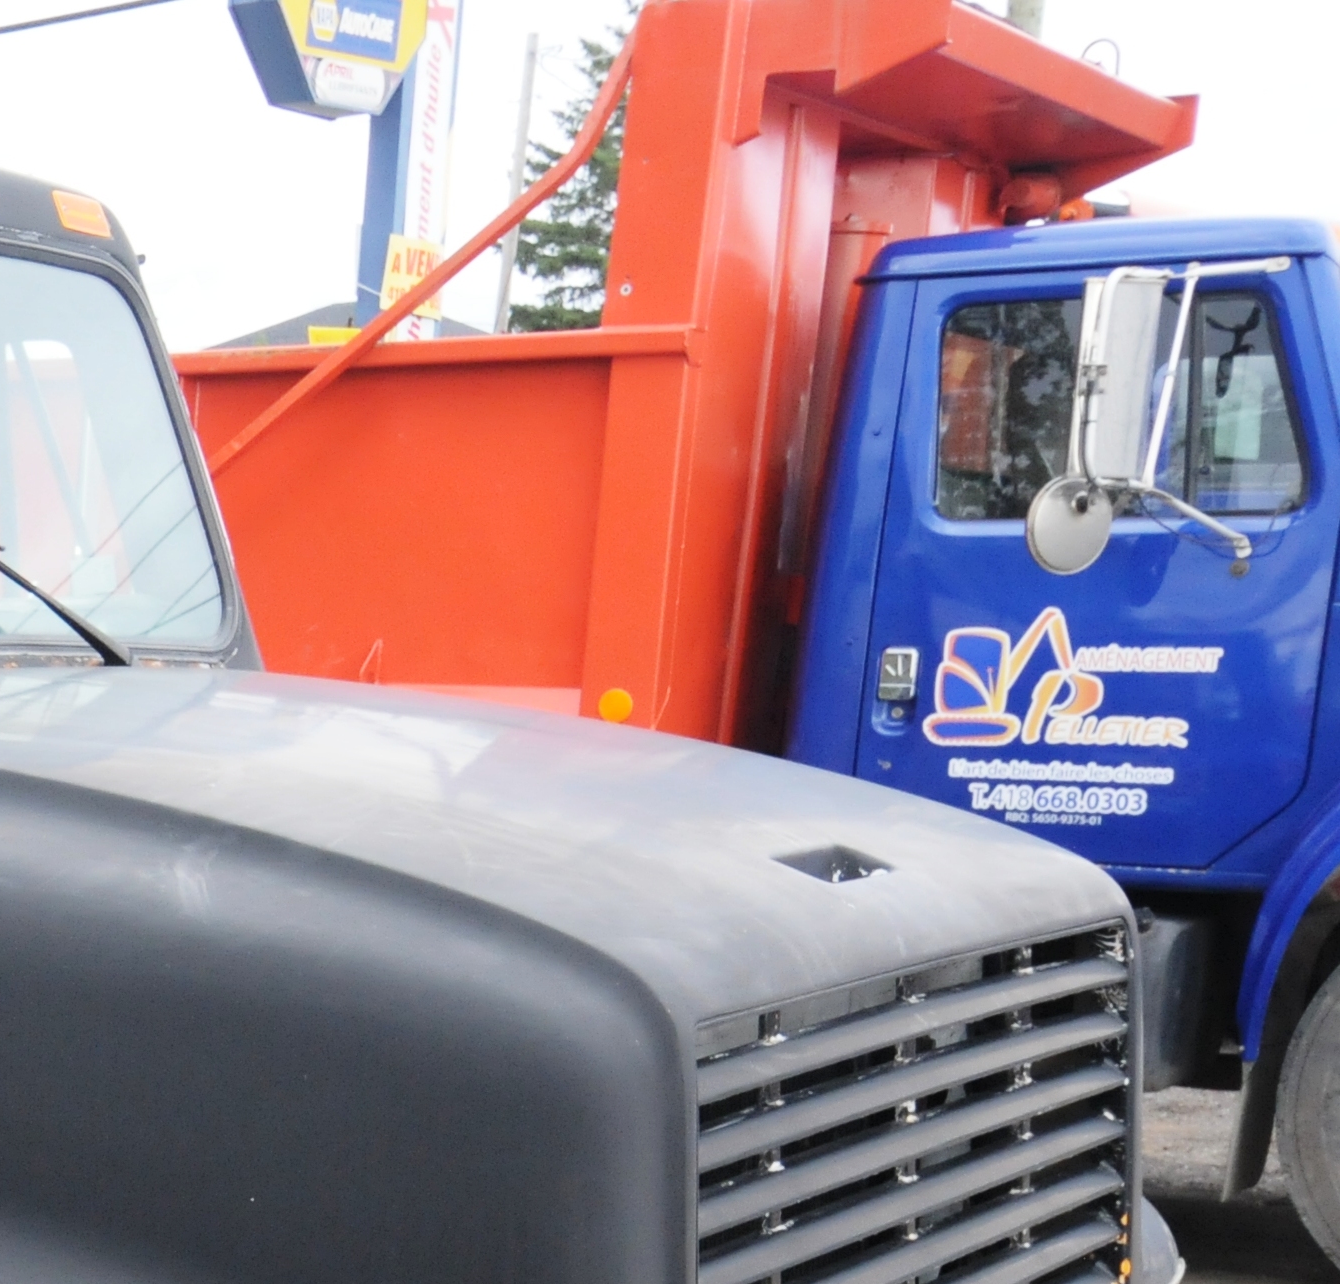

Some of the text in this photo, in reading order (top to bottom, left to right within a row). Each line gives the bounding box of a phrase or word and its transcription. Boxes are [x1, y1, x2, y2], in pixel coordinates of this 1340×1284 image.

[1075, 645, 1222, 671] AMÉNAGEMENT
[987, 761, 1009, 778] de
[1011, 761, 1046, 780] bien
[1049, 762, 1085, 781] faire
[1088, 763, 1111, 781] les
[1114, 764, 1172, 783] choses
